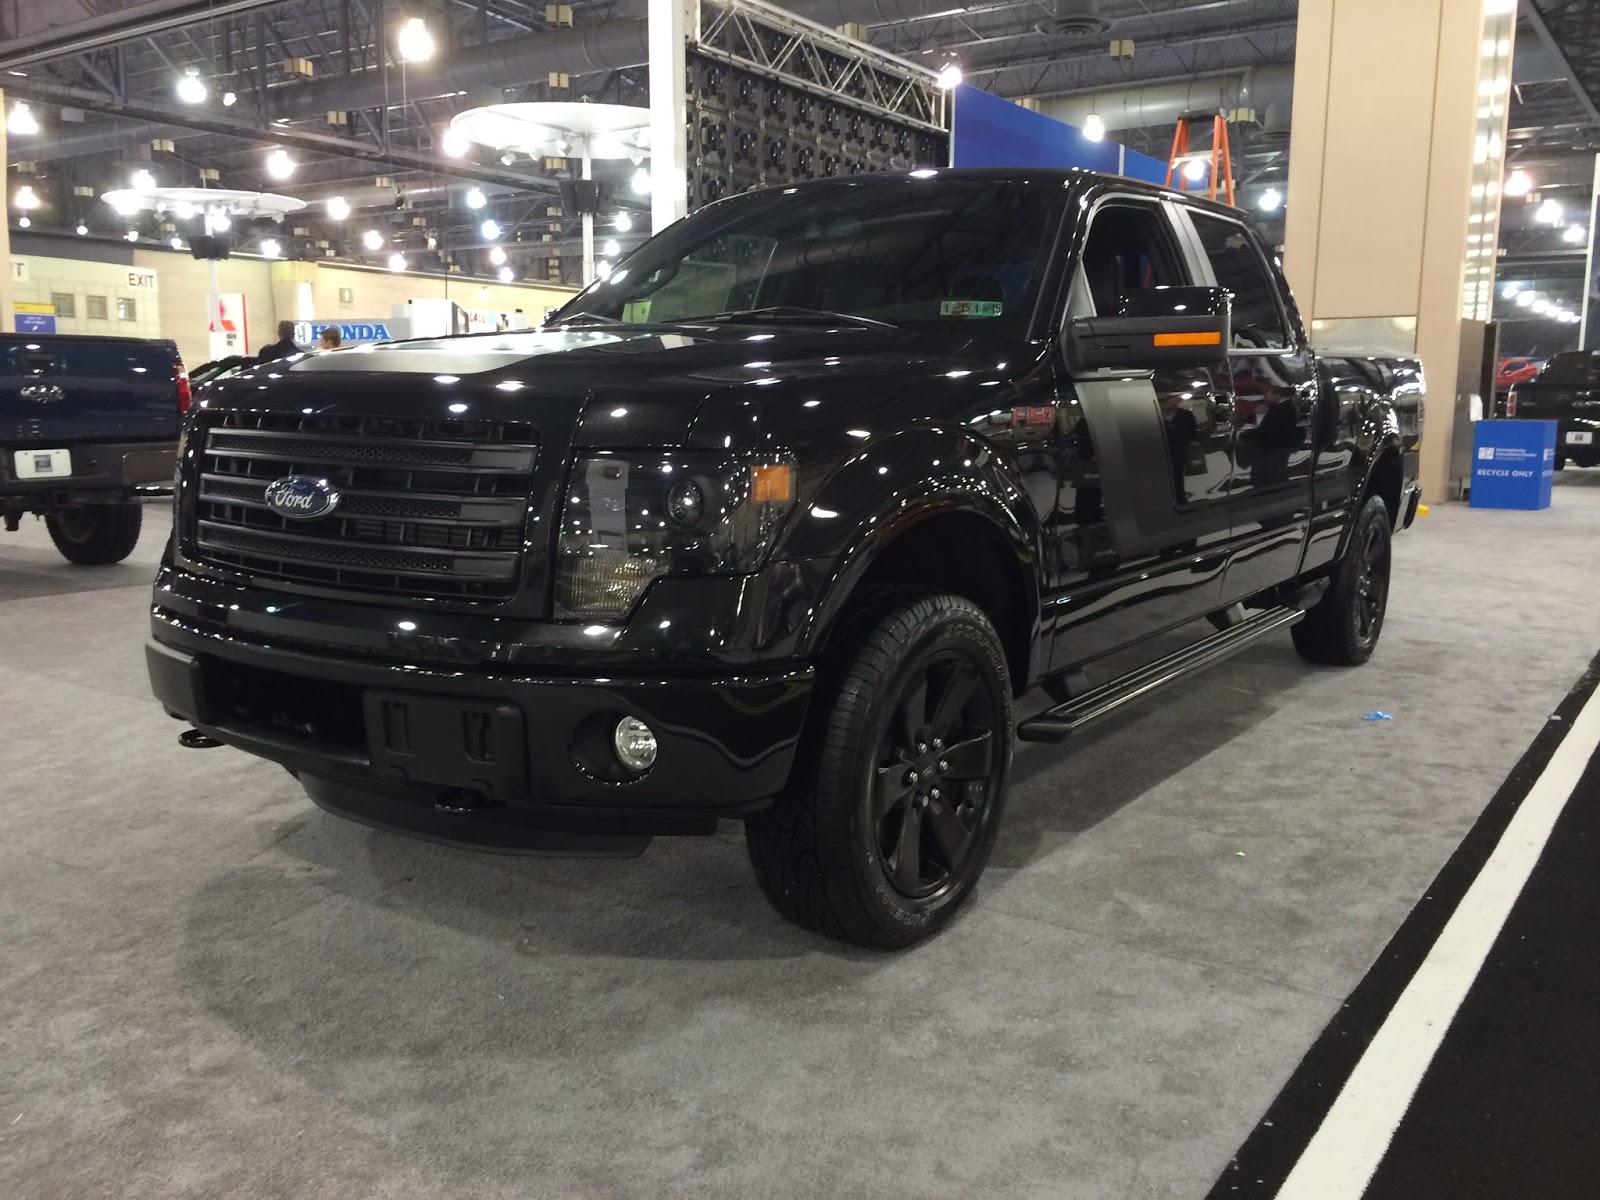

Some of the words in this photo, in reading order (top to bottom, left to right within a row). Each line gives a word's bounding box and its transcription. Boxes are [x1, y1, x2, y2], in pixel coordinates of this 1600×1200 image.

[128, 272, 155, 288] EXIT
[311, 324, 391, 340] HNDA
[1477, 469, 1510, 477] RECYCLE
[275, 482, 316, 509] Ford
[943, 624, 1006, 681] SCORPION
[876, 885, 931, 926] PIRELLI
